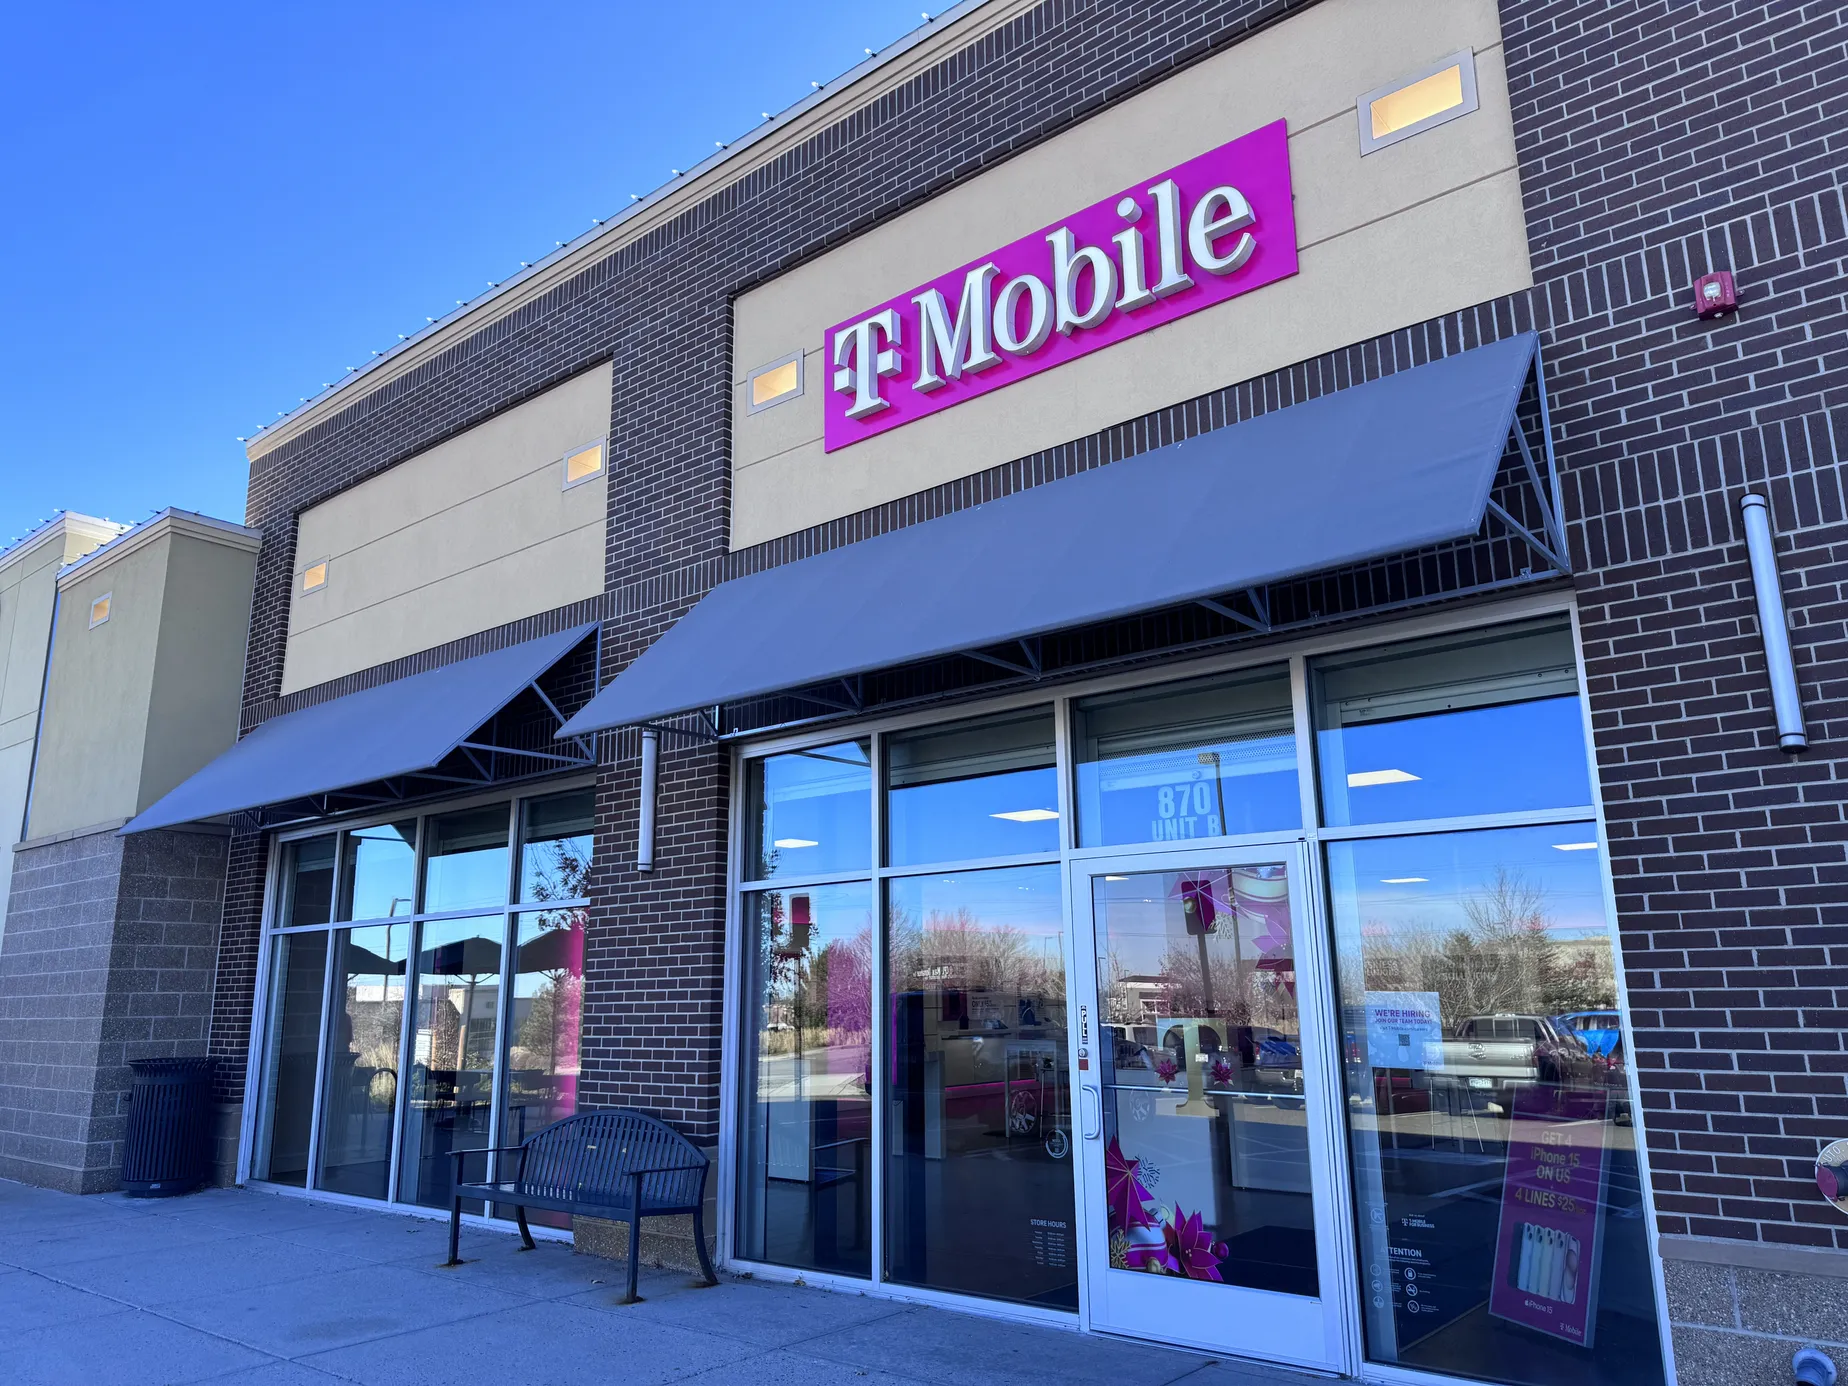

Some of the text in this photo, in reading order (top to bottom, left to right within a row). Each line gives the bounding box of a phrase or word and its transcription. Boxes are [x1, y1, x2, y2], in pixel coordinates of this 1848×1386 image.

[911, 178, 1257, 393] Mobile
[1158, 781, 1211, 819] 870
[1151, 814, 1220, 841] UNIT B
[1374, 1009, 1431, 1018] WE'RE HIRING
[1541, 1130, 1573, 1147] GET 4
[1530, 1146, 1581, 1168] iPhone 15
[1821, 1145, 1845, 1165] UTO.
[1536, 1164, 1571, 1184] ON US
[1515, 1187, 1523, 1200] 4
[1525, 1189, 1556, 1208] LINES
[1030, 1218, 1067, 1229] STORE HOURS
